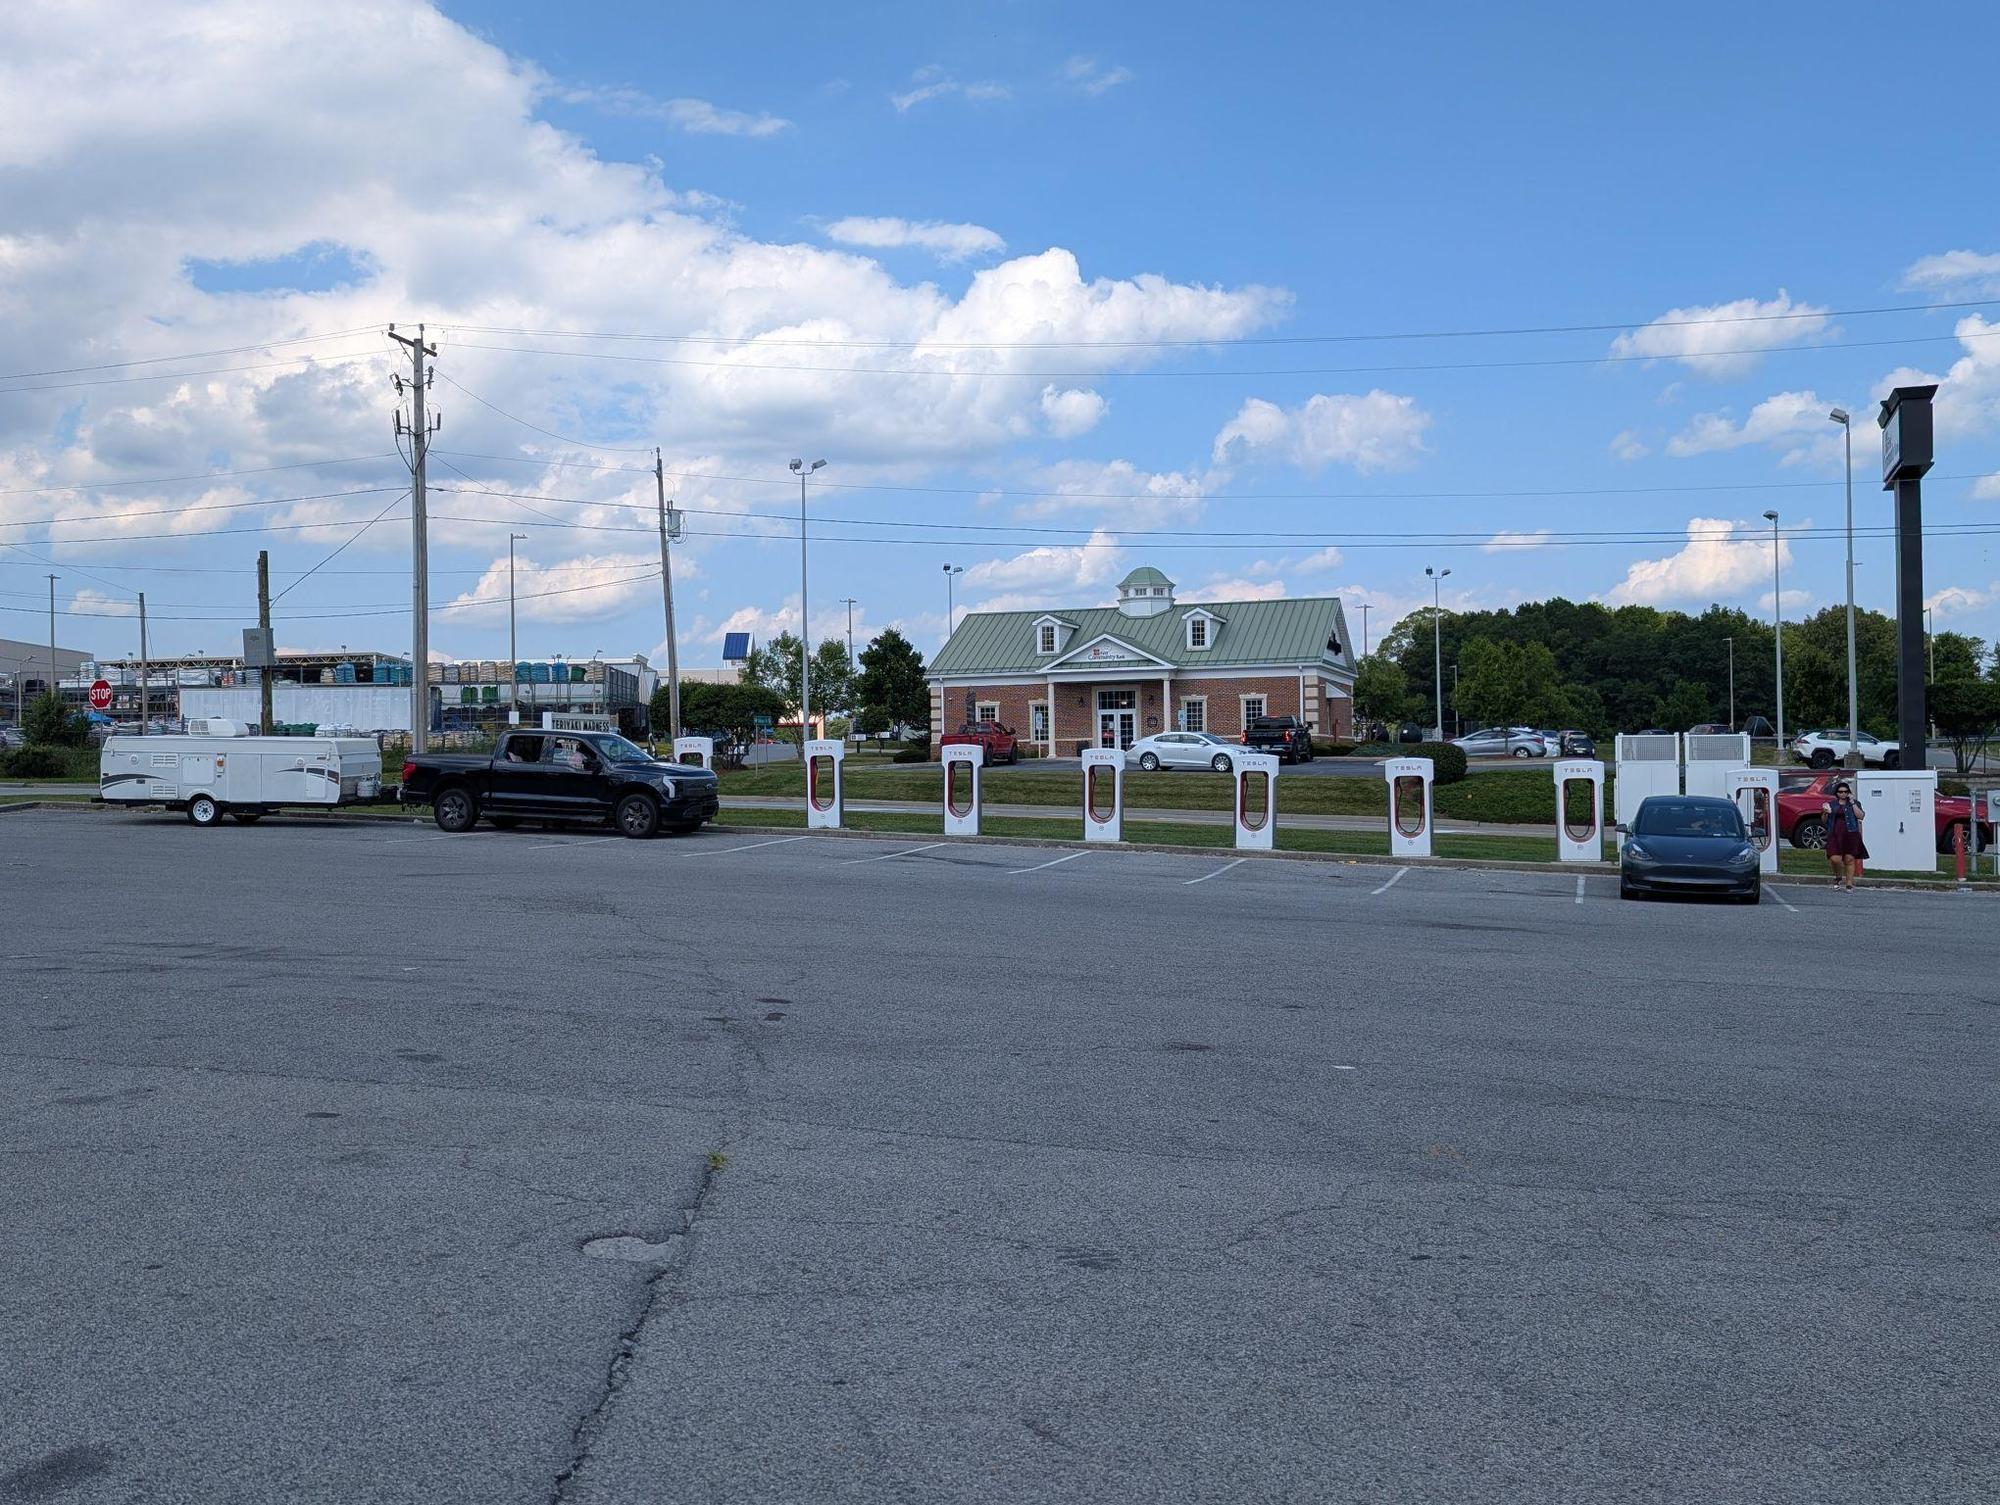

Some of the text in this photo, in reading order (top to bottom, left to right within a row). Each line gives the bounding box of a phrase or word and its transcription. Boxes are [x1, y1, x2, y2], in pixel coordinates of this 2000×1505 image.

[1088, 653, 1115, 661] Community
[91, 688, 111, 700] STOP
[552, 720, 610, 732] TERIYAKI MADNESS
